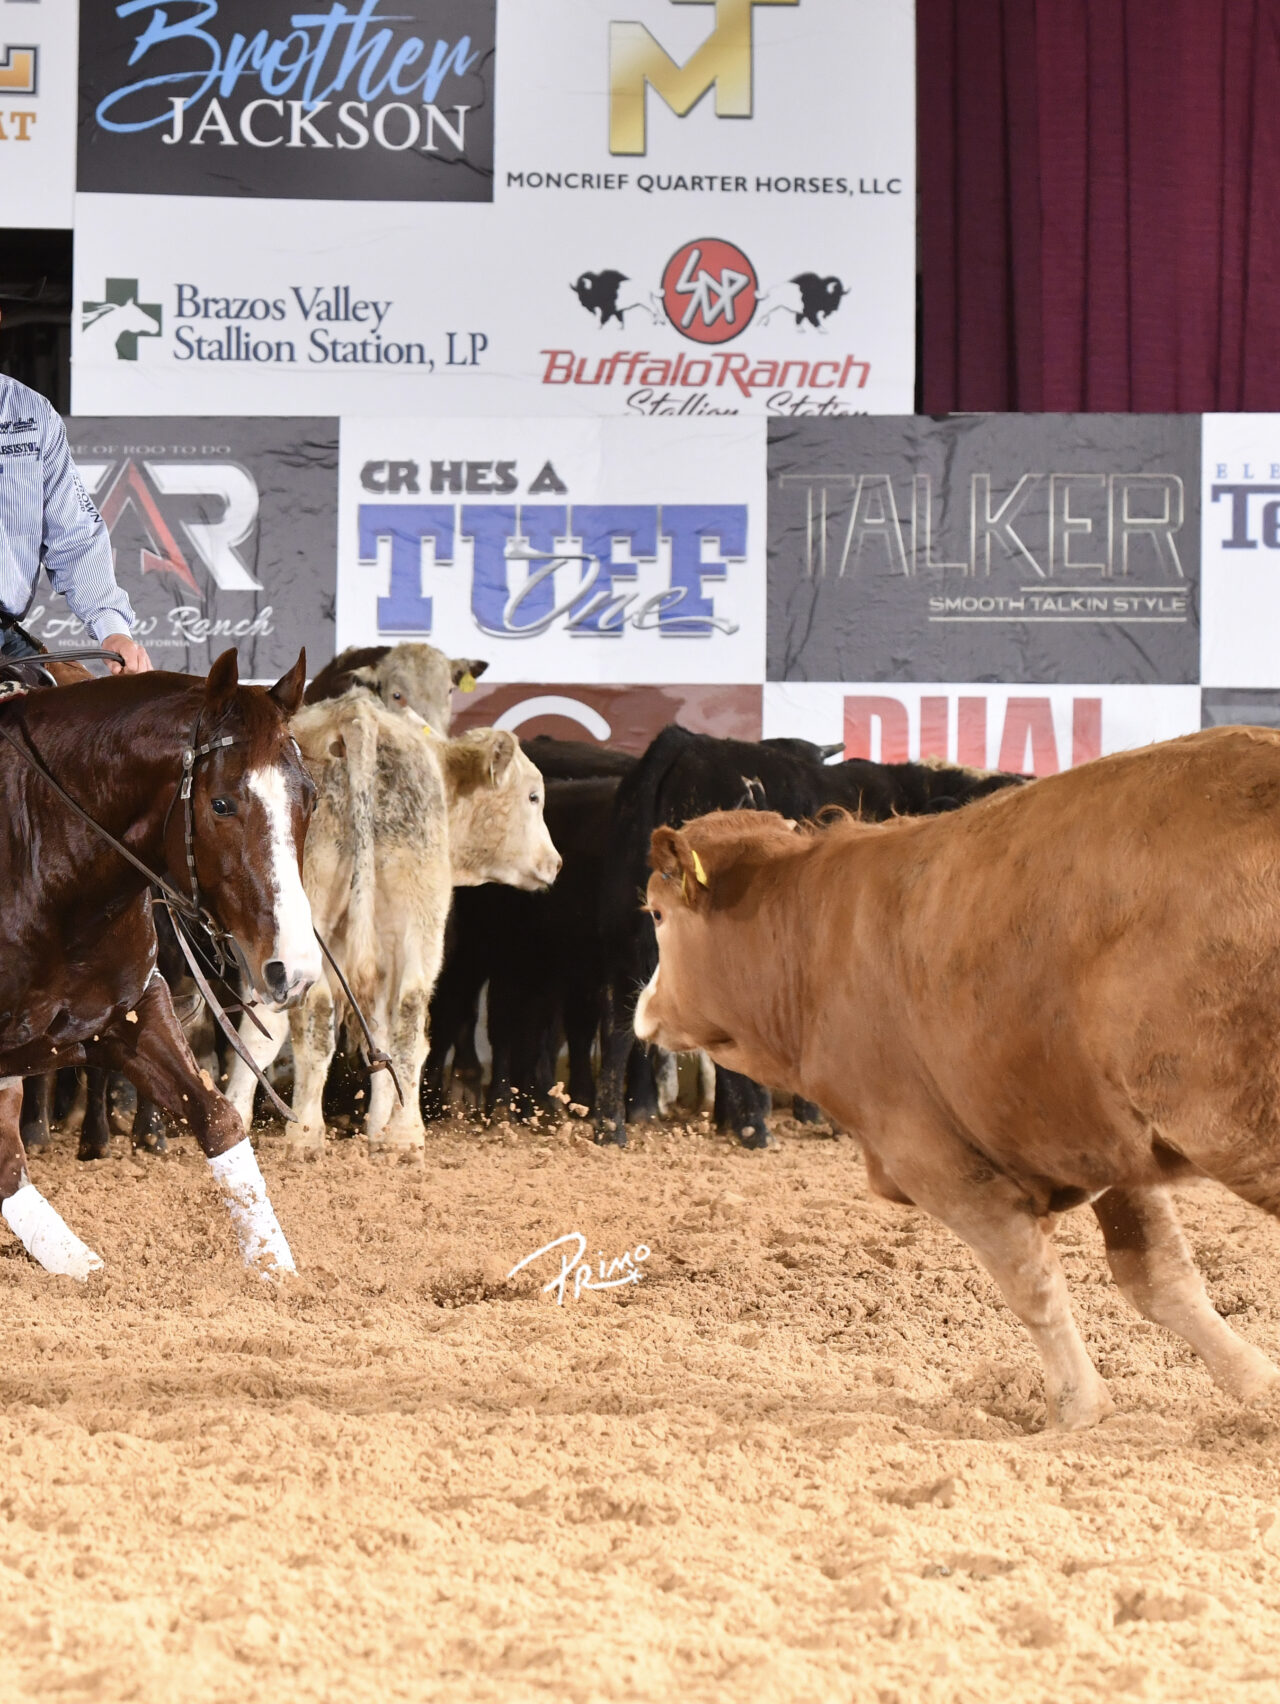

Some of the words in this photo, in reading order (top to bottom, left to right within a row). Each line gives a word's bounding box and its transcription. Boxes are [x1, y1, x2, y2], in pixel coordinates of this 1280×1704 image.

[96, 0, 480, 133] Brother
[161, 96, 472, 152] JACKSON
[506, 171, 629, 191] MONCRIEF
[637, 174, 749, 194] QUARTER
[755, 177, 854, 197] HORSES,
[860, 178, 902, 194] LLC
[174, 283, 287, 322] Brazos
[290, 285, 393, 335] Valley
[173, 325, 298, 364] Stallion
[308, 328, 436, 374] Station,
[445, 331, 490, 367] LP
[540, 350, 714, 386] Buffalo
[711, 352, 872, 399] Ranch
[360, 459, 419, 495] CR
[430, 459, 518, 495] HES
[528, 459, 568, 495] A
[778, 473, 1186, 579] TALKER
[358, 504, 748, 639] TUFF
[503, 538, 741, 635] One
[168, 606, 275, 643] Ranch
[928, 596, 1024, 613] SMOOTH
[1030, 597, 1108, 613] TALKIN
[1113, 597, 1187, 613] STYLE
